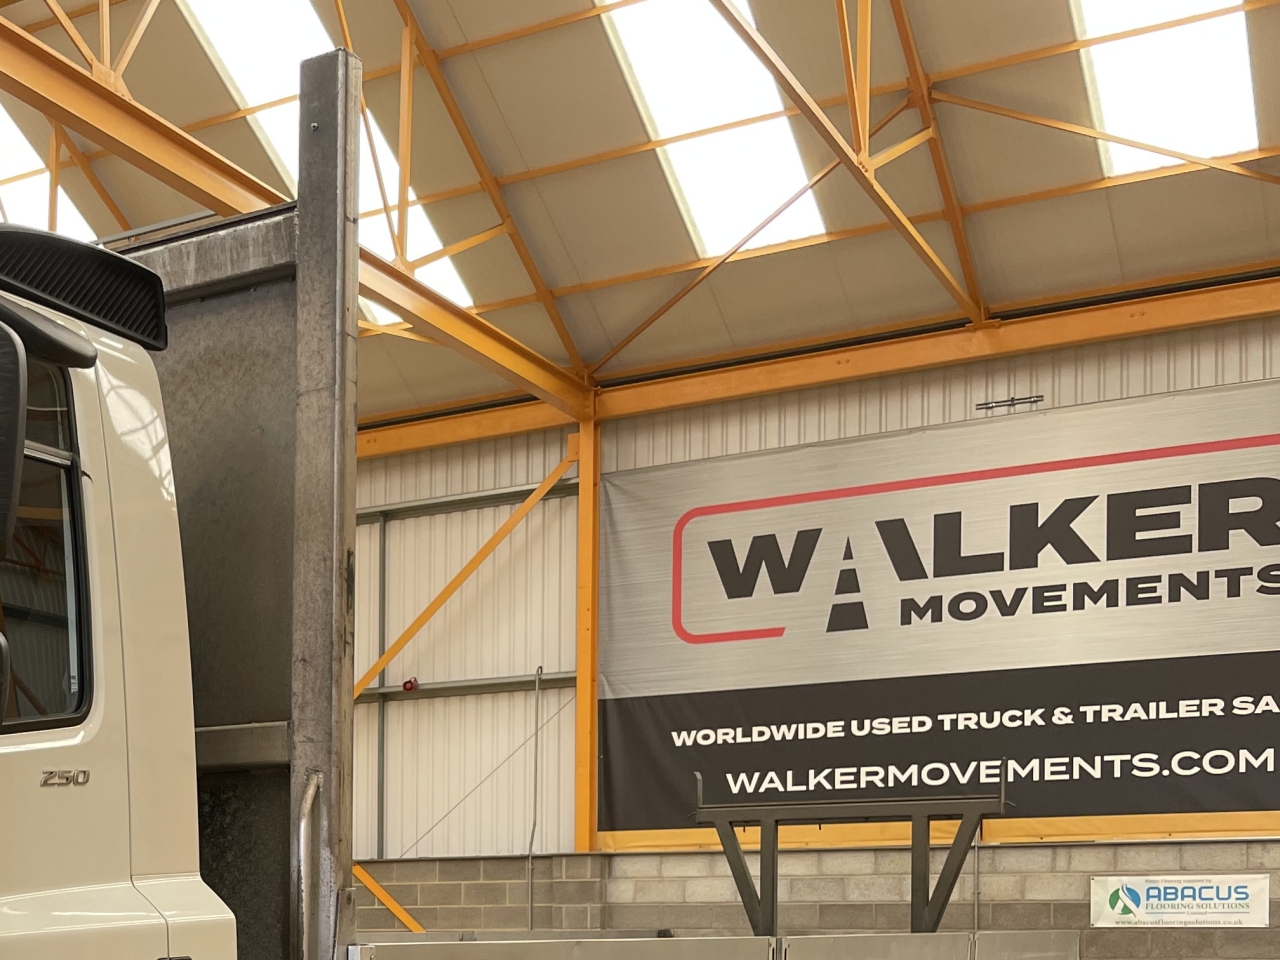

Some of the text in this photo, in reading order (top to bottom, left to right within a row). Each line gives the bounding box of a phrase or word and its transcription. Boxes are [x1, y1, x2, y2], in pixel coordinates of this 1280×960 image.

[707, 477, 1280, 633] WALKER
[900, 563, 1280, 627] MOVEMENTS
[671, 721, 845, 747] WORLDWIDE
[850, 715, 933, 737] USED
[937, 708, 1046, 731] TRUCK
[1051, 706, 1074, 725] &
[1079, 698, 1225, 724] TRAILER
[40, 769, 91, 787] 250
[725, 747, 1275, 795] WALKERMOVEMENTS.COM
[1145, 885, 1250, 902] ABACUS
[1145, 902, 1250, 910] FLOORING SOLUTIONS
[1114, 918, 1243, 927] www.abacusflooringsolutions.co.uk
